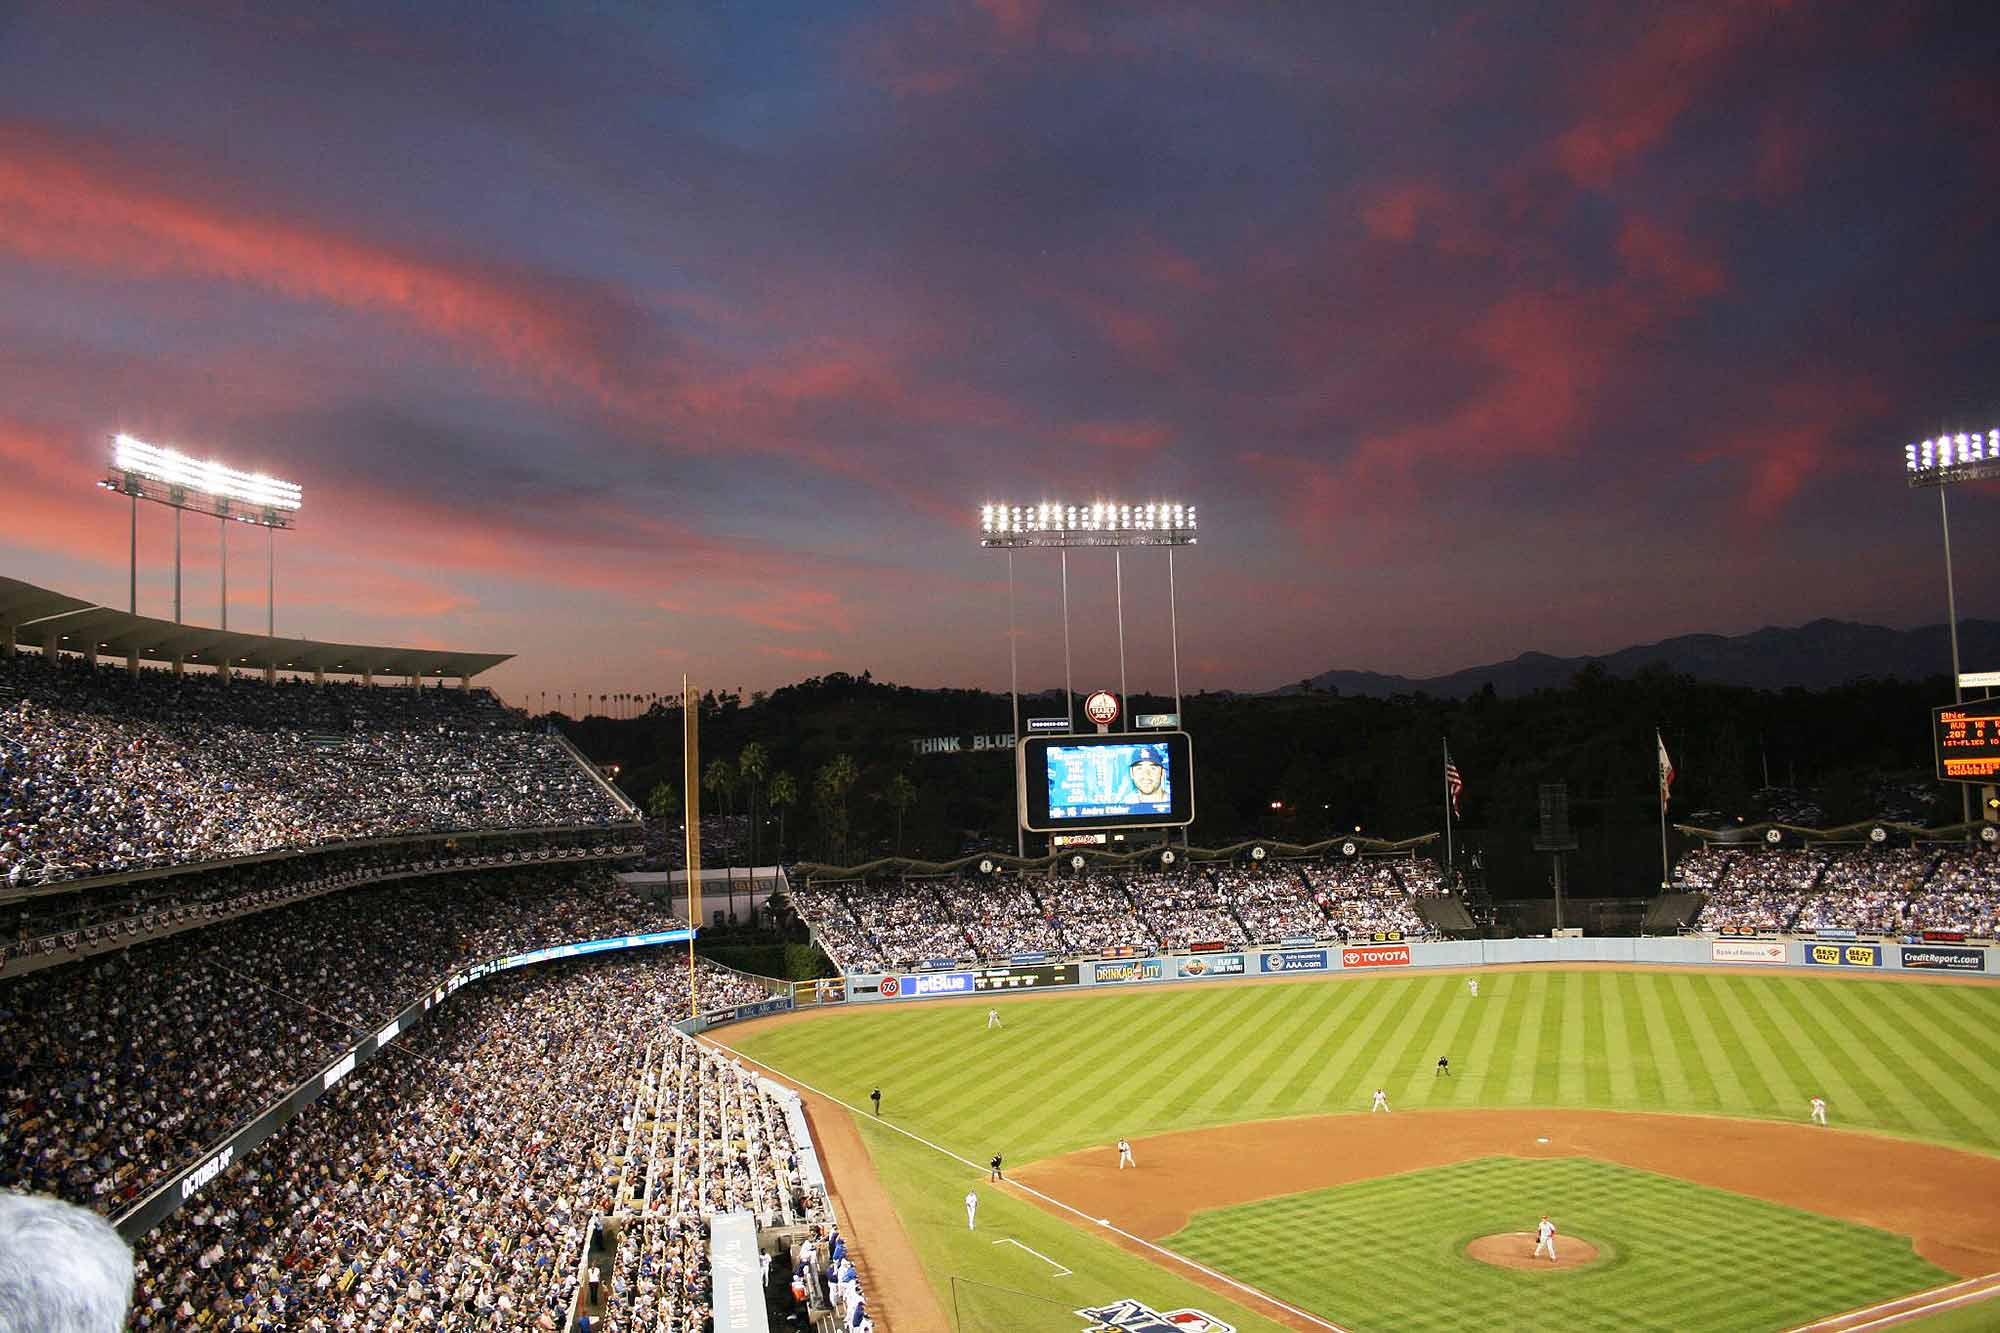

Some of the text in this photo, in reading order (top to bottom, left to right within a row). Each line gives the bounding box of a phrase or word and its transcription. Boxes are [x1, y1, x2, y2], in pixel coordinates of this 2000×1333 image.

[1941, 712, 1966, 720] Ethier
[1945, 730, 1966, 739] .207
[910, 733, 1016, 753] THINK BLUE
[1362, 951, 1408, 962] TOYOTA
[1815, 948, 1839, 956] BEST
[1848, 949, 1872, 957] BEST
[1849, 955, 1869, 963] BUY
[1904, 953, 1978, 964] CreditReport.com
[1286, 961, 1320, 969] AAA.com
[883, 981, 896, 992] 76
[916, 975, 965, 995] jetBlue
[182, 1156, 219, 1199] OCTOBER
